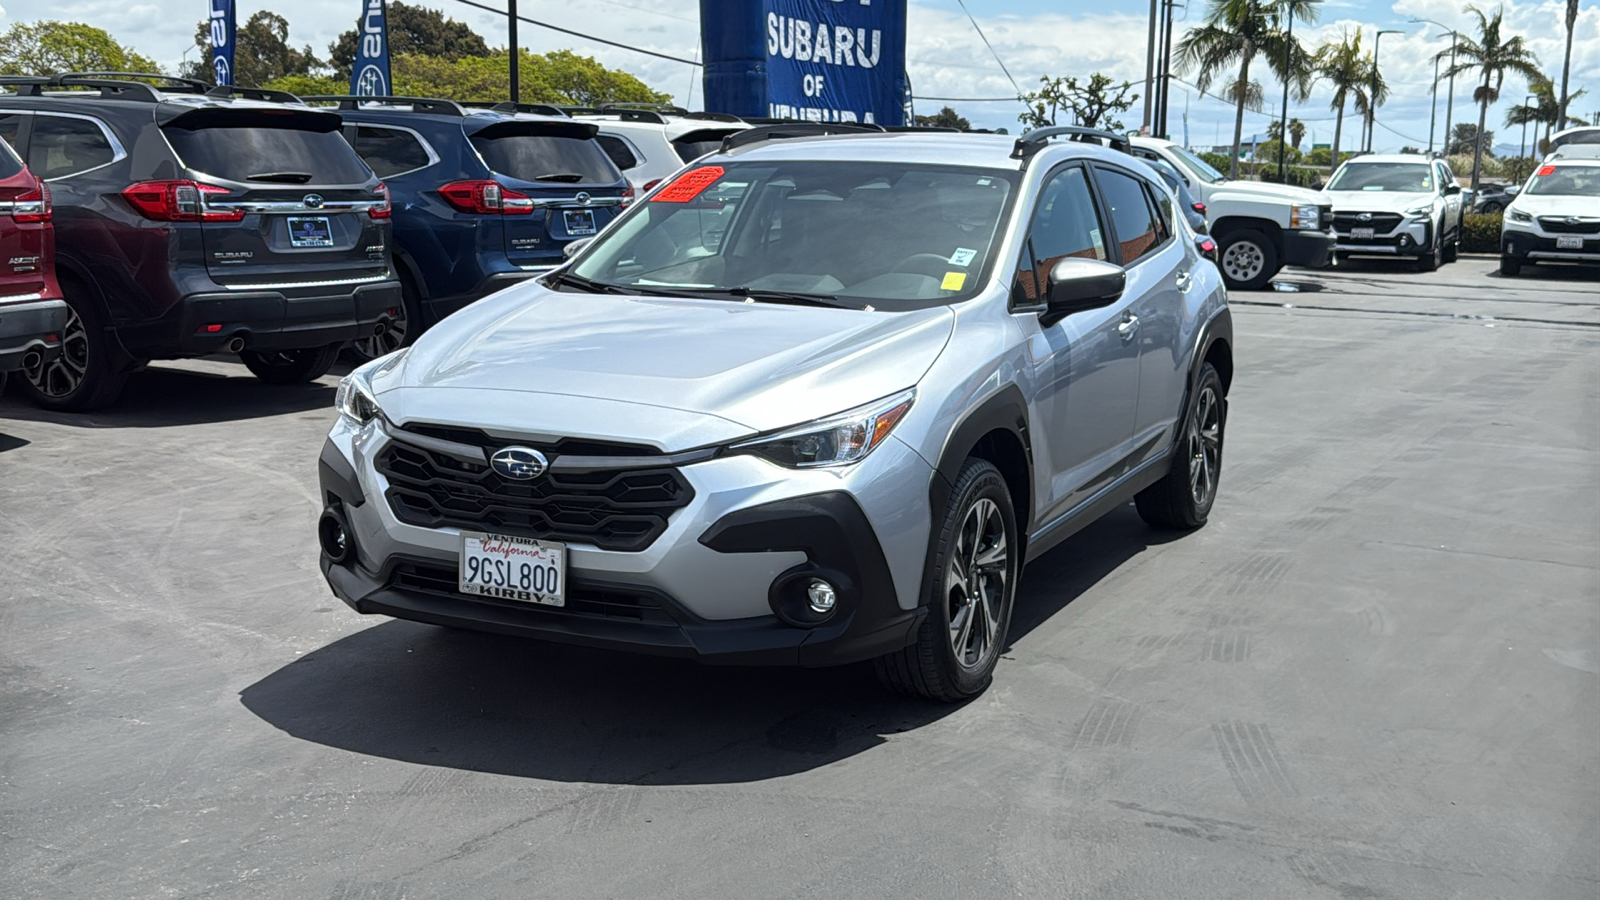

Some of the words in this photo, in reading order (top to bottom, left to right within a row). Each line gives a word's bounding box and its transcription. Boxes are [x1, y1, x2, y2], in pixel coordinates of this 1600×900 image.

[767, 11, 882, 69] SUBARU
[803, 74, 824, 97] OF
[482, 539, 546, 559] California
[486, 533, 539, 546] VENTURA
[468, 556, 558, 594] 9GSL800
[480, 585, 546, 602] KIRBY
